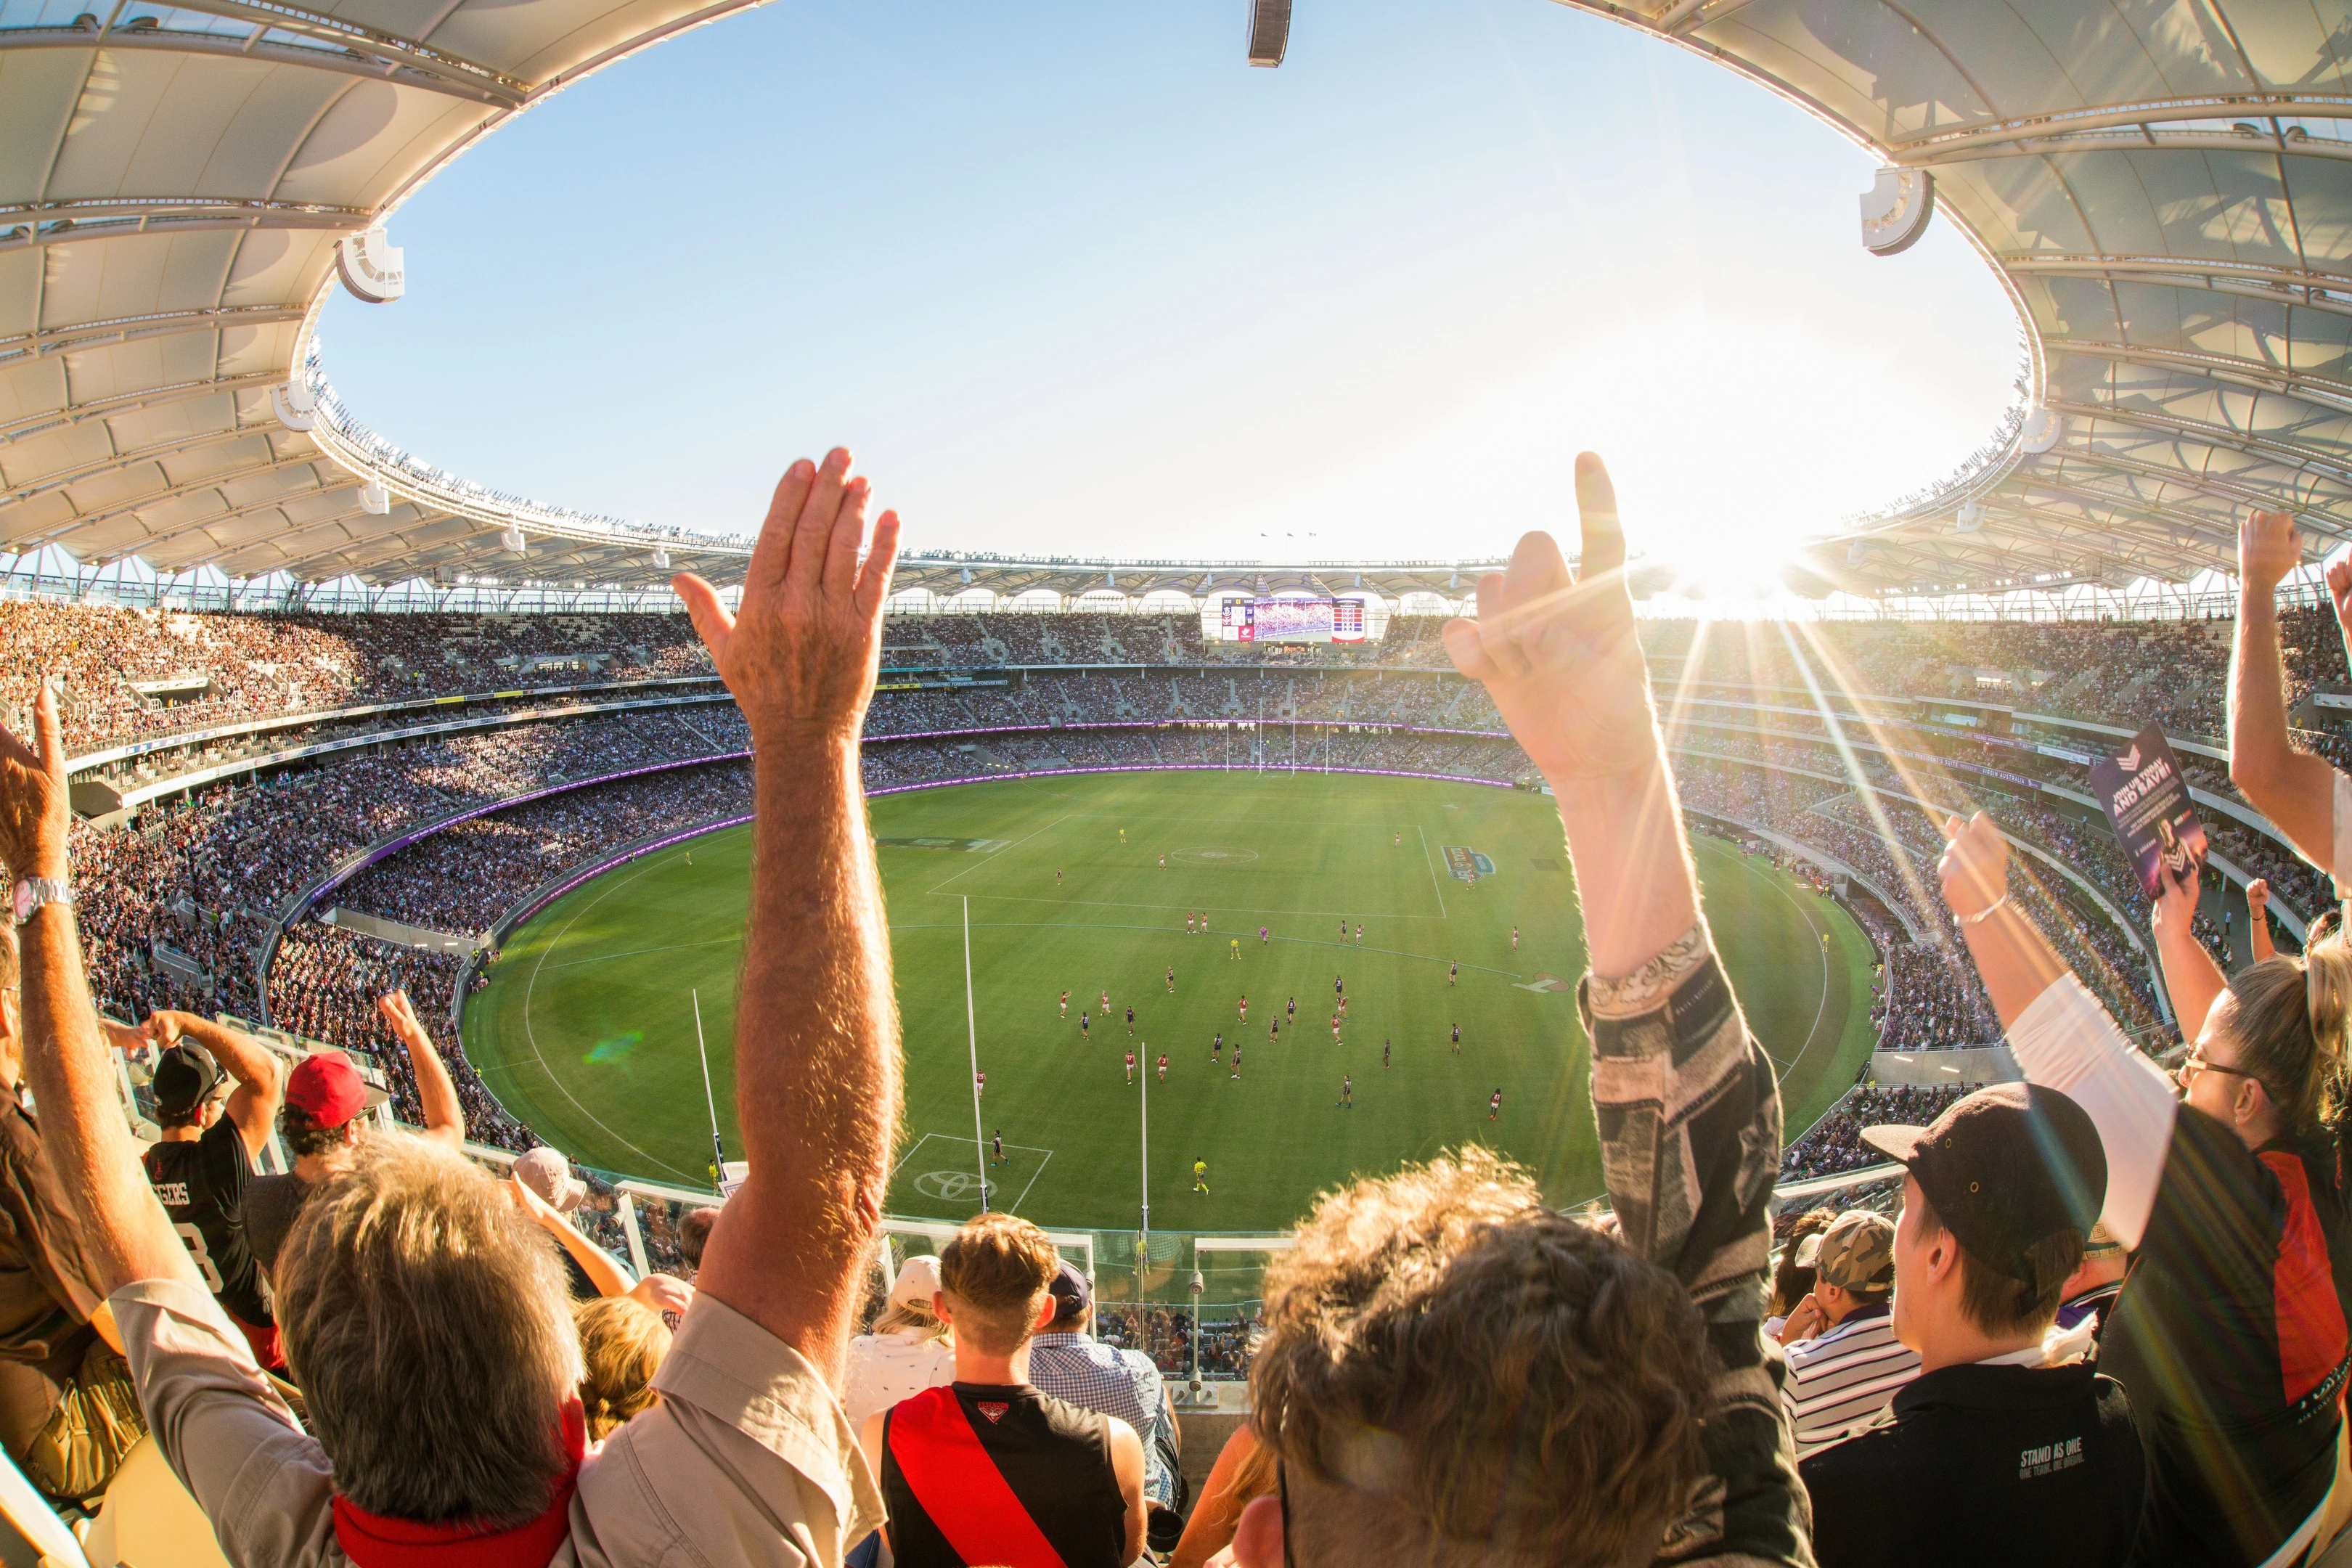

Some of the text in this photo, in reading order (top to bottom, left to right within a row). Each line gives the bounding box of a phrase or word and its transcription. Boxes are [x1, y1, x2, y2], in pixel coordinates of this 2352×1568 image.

[1914, 754, 1943, 764] PRESIDENT'S
[1982, 768, 2025, 784] VIRGIN AUSTRALIA
[2112, 757, 2163, 802] JOIN US TODAY
[2113, 791, 2138, 817] AND
[2020, 1437, 2082, 1468] STAND AS ONE
[2020, 1466, 2032, 1480] ONE
